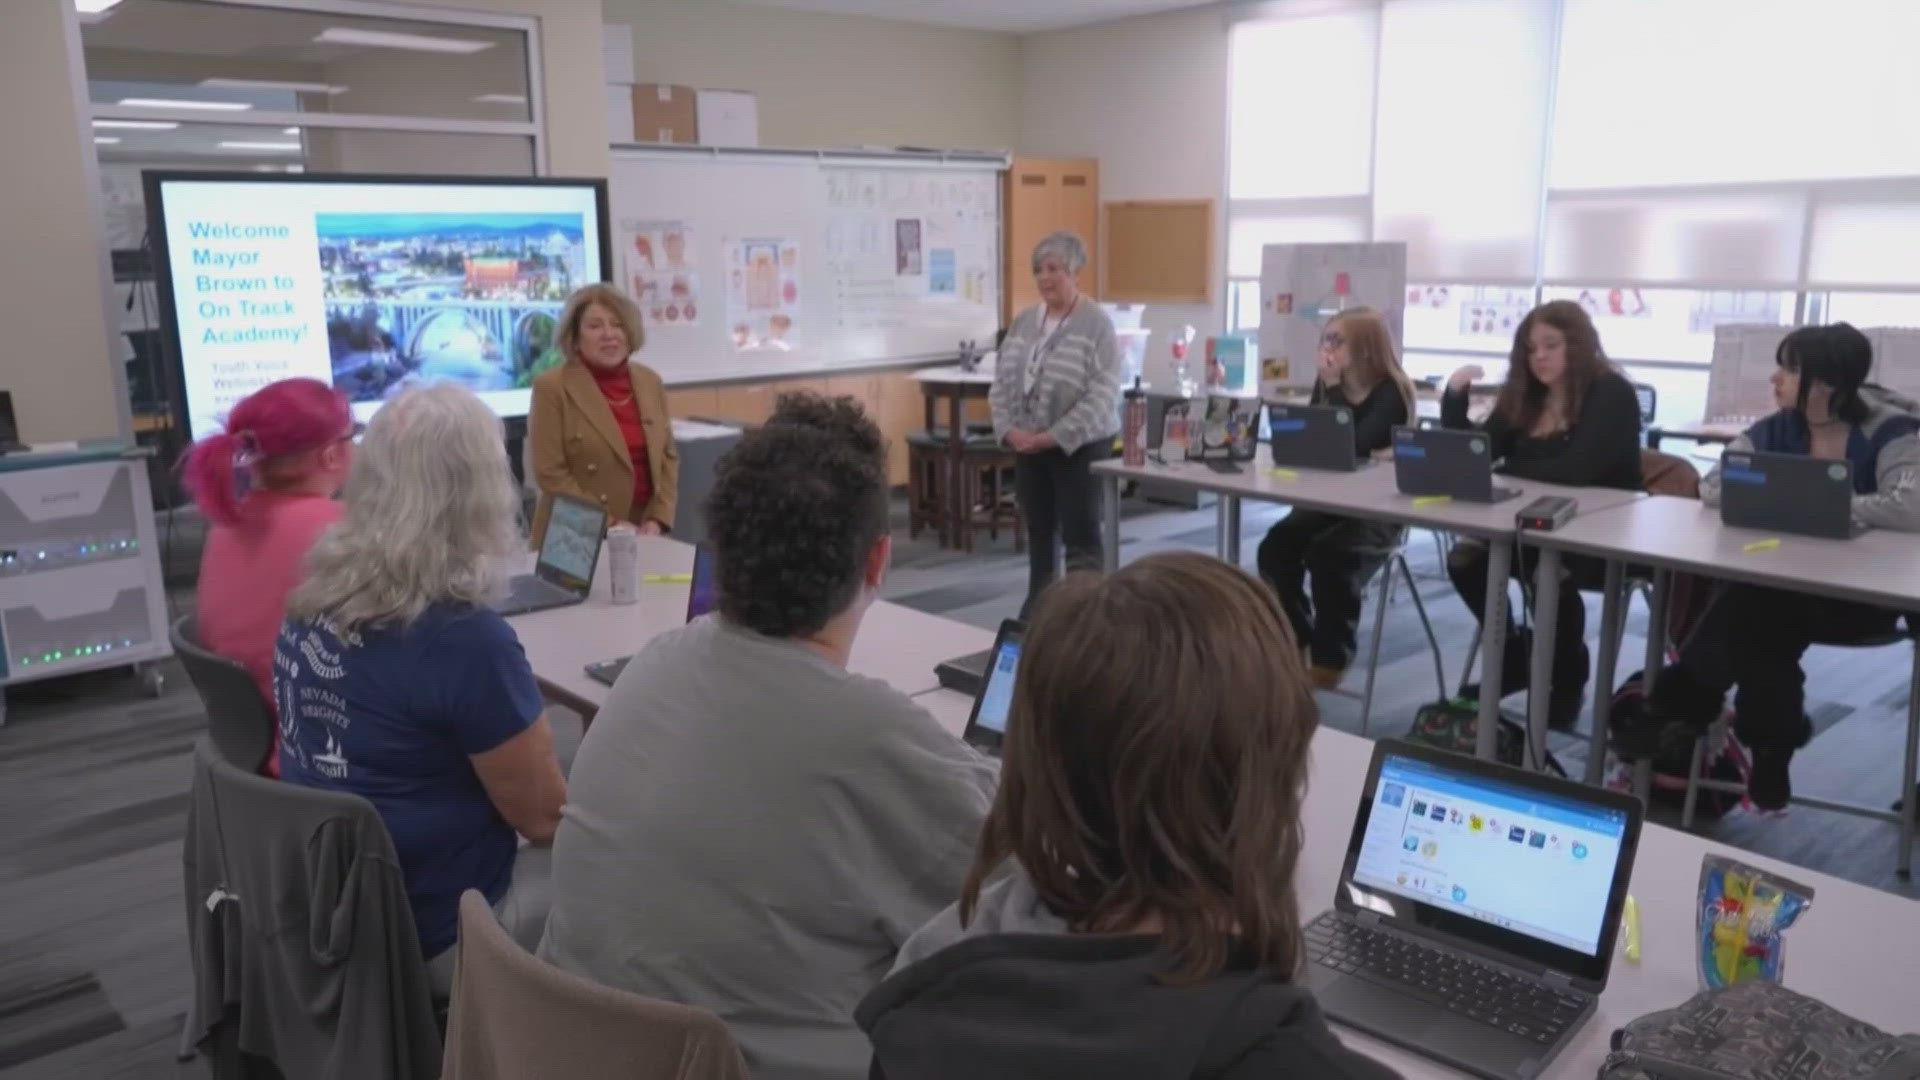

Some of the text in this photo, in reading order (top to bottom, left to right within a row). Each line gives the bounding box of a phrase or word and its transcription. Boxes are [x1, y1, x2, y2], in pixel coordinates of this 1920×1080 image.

[189, 222, 289, 239] Welcome
[193, 248, 259, 268] Mayor
[196, 274, 294, 292] Brown to
[199, 300, 295, 319] On Track
[202, 324, 309, 345] Academy!
[300, 687, 346, 712] NEVADA
